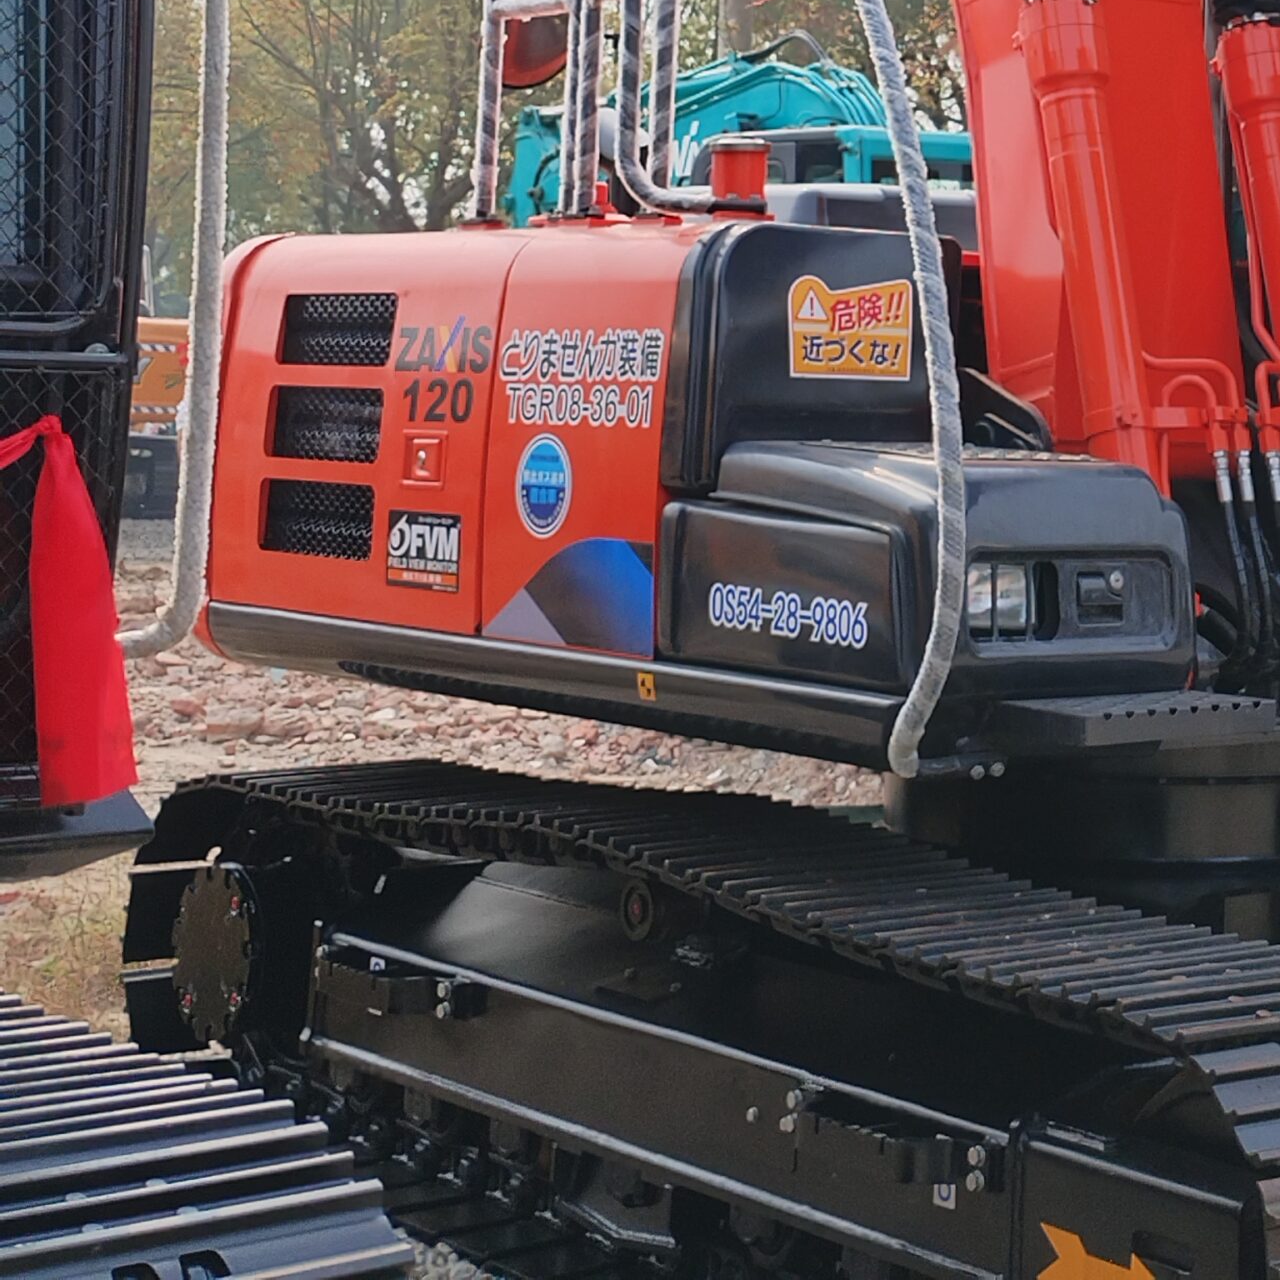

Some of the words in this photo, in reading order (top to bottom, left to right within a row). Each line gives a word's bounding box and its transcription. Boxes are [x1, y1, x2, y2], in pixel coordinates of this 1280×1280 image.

[829, 290, 905, 333] 危険!!
[394, 315, 493, 375] ZAXIS
[801, 335, 902, 368] 近づくな!
[402, 377, 475, 424] 120
[507, 383, 654, 428] TGR08-36-01
[409, 523, 460, 562] FVM
